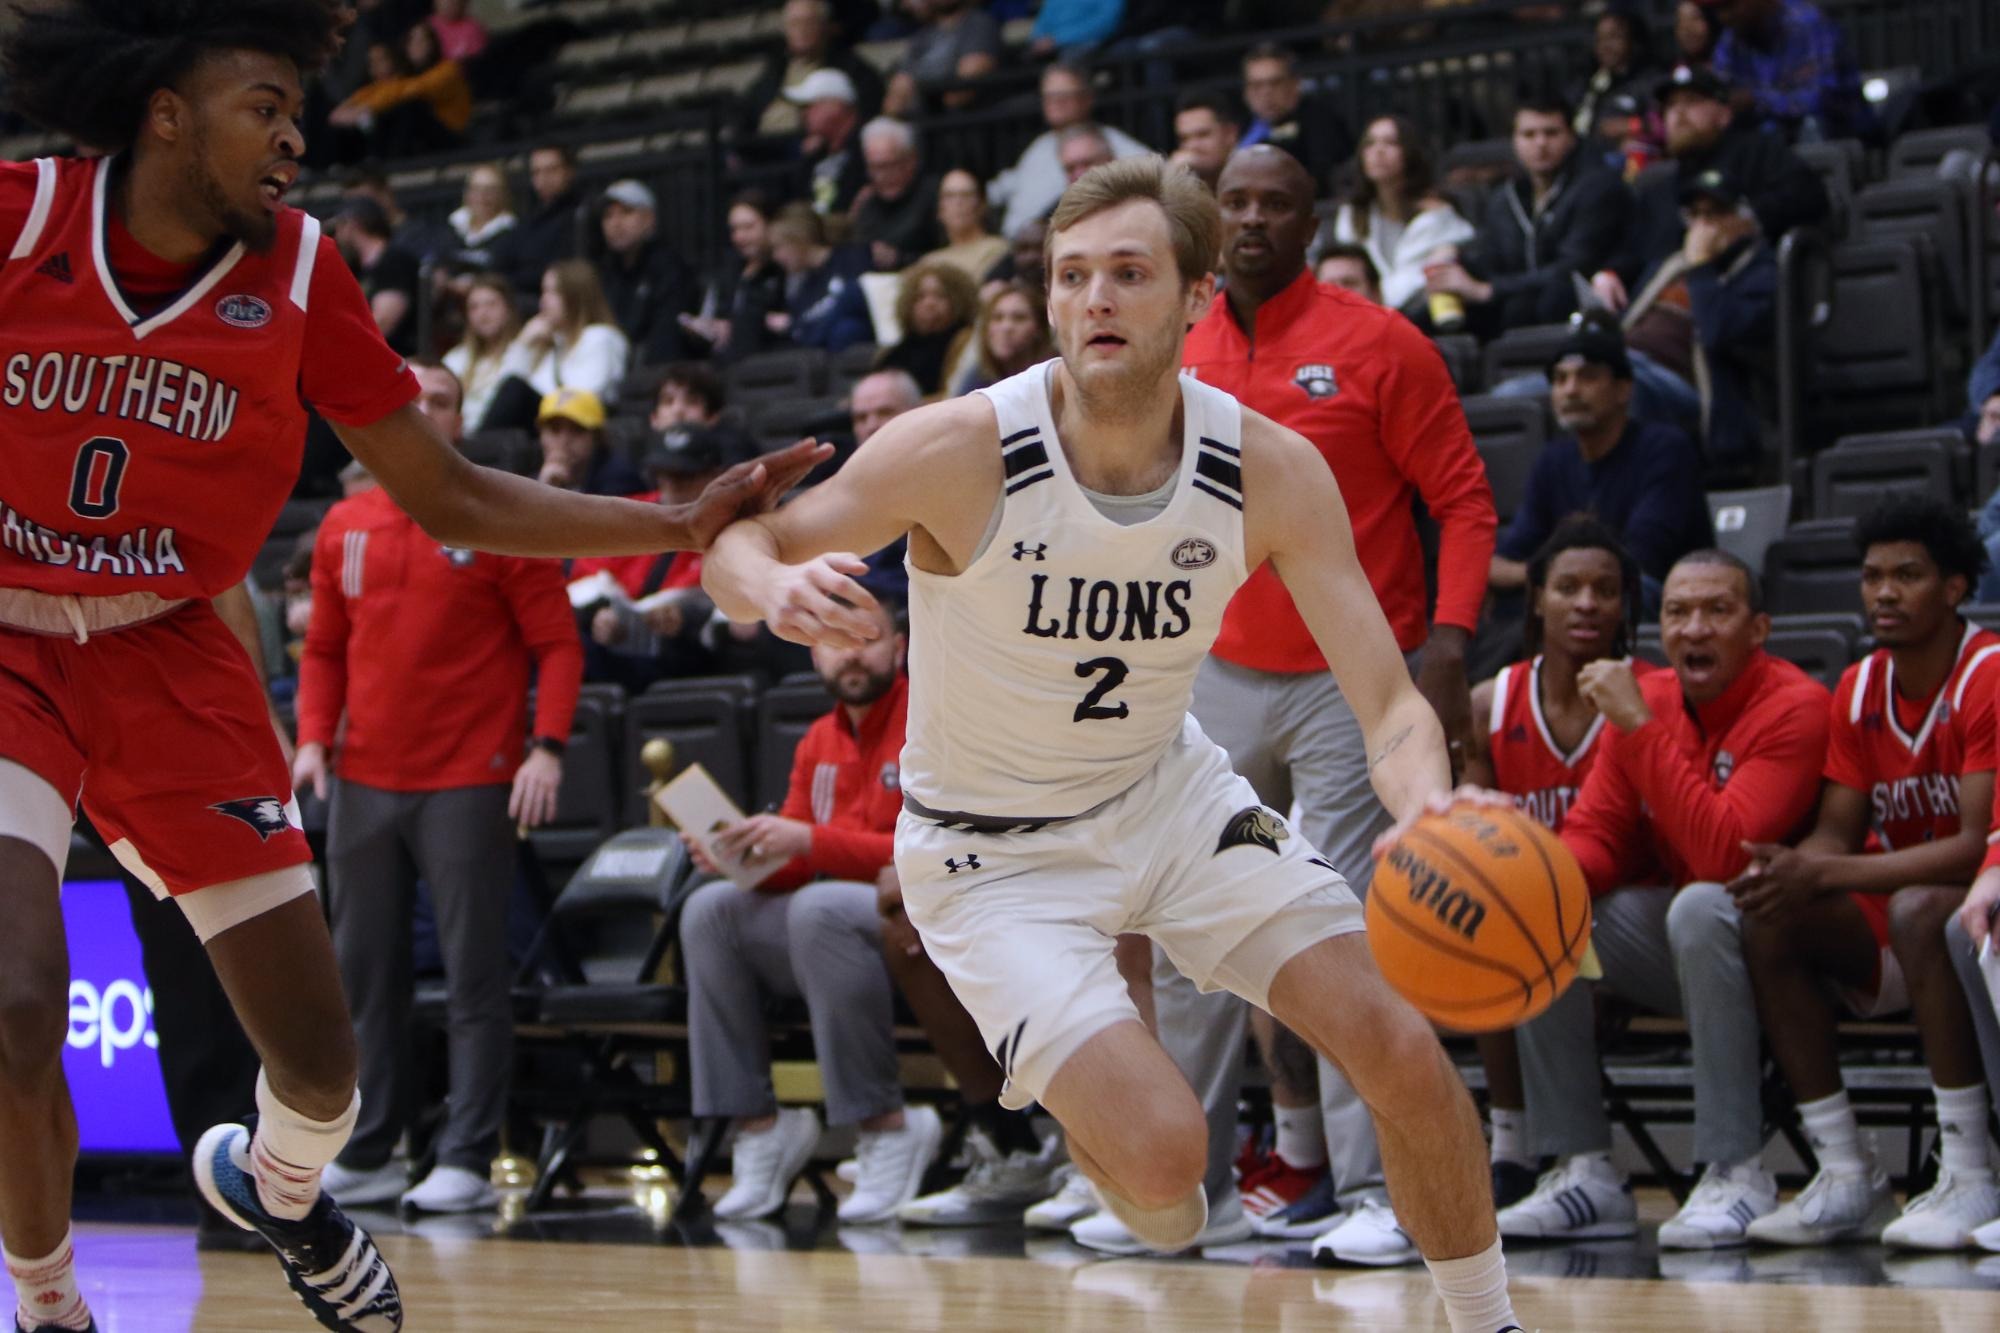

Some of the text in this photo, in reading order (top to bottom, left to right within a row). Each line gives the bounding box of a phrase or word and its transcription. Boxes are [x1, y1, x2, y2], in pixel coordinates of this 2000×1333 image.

[3, 351, 239, 442] SOUTHERN
[1295, 364, 1334, 381] USI
[67, 436, 131, 520] 0
[0, 500, 186, 575] NDIANA
[1022, 574, 1192, 642] LIONS
[1073, 656, 1130, 723] 2
[1513, 786, 1581, 830] OUT
[1871, 773, 1960, 821] SUTHR
